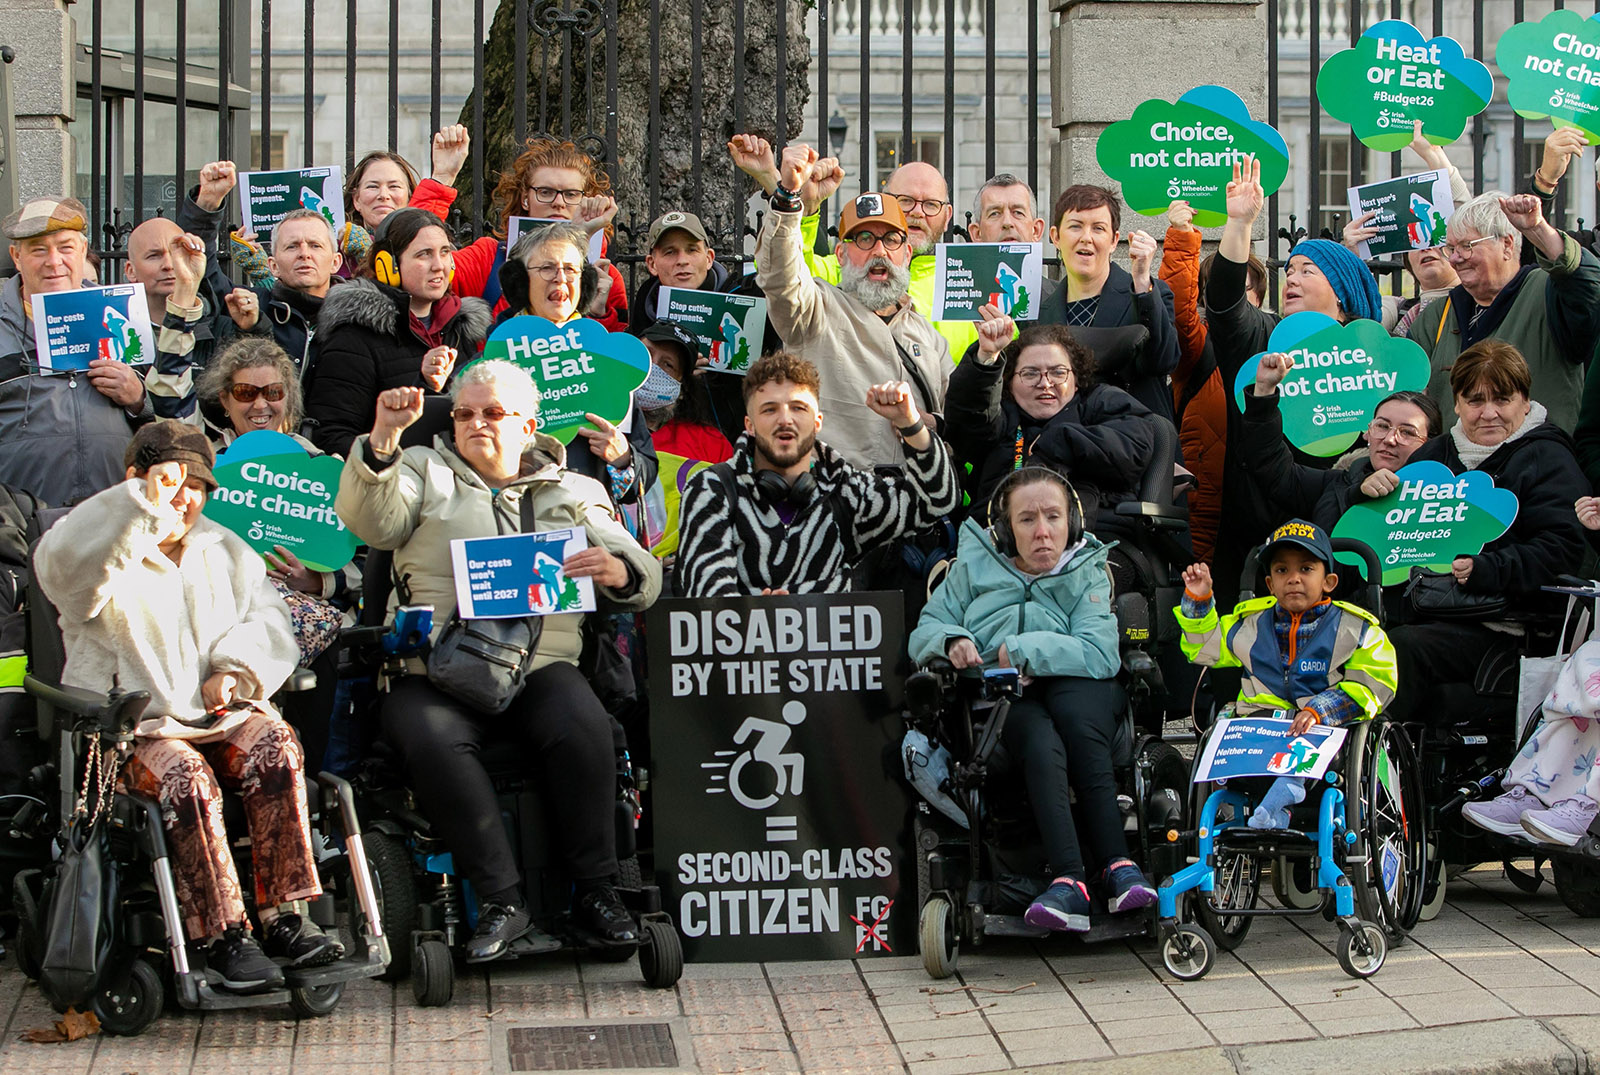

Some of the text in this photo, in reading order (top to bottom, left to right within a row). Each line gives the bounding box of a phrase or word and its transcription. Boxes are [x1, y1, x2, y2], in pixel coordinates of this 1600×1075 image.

[1376, 38, 1441, 65] Heat
[1553, 33, 1600, 60] Choi
[1367, 64, 1445, 90] or Eat
[1524, 55, 1600, 87] not cha
[1373, 91, 1434, 106] #Budget26
[1564, 98, 1599, 112] Wheelchair
[1150, 122, 1234, 144] Choice,
[1130, 149, 1169, 167] not
[250, 184, 290, 194] Stop cutting
[251, 194, 285, 205] payments.
[1361, 194, 1396, 208] Next year's
[252, 214, 271, 222] Start
[1381, 214, 1396, 222] heat
[1368, 235, 1386, 245] today
[947, 258, 962, 267] Stop
[947, 269, 972, 278] pushing
[947, 279, 974, 287] disabled
[946, 289, 982, 299] people into
[670, 301, 712, 316] Stop cutting
[945, 300, 973, 310] poverty
[47, 313, 85, 324] Our costs
[48, 325, 70, 334] won't
[50, 336, 67, 346] wait
[506, 328, 583, 360] Heat
[51, 343, 90, 356] until 2027
[1288, 345, 1373, 369] Choice,
[541, 352, 595, 381] Eat
[1315, 369, 1397, 394] charity
[546, 410, 584, 421] Wheelchair
[1327, 409, 1364, 418] Wheelchair
[240, 462, 331, 501] Choice,
[1399, 479, 1469, 501] Heat
[213, 486, 257, 508] not
[1385, 502, 1468, 525] or Eat
[266, 524, 282, 532] Irish
[265, 530, 305, 544] Wheelchair
[1387, 529, 1451, 542] #Budget26
[469, 559, 512, 569] Our costs
[470, 570, 495, 580] won't
[472, 581, 492, 590] wait
[473, 588, 518, 601] until 2027
[669, 604, 883, 657] DISABLED
[1301, 661, 1326, 672] GARDA
[672, 656, 883, 697] BY THE STATE
[1228, 725, 1256, 733] Winter
[1224, 732, 1242, 740] wait.
[1217, 748, 1247, 757] Neither
[677, 846, 893, 885] SECOND-CLASS
[680, 887, 840, 938] CITIZEN
[856, 896, 890, 921] FG
